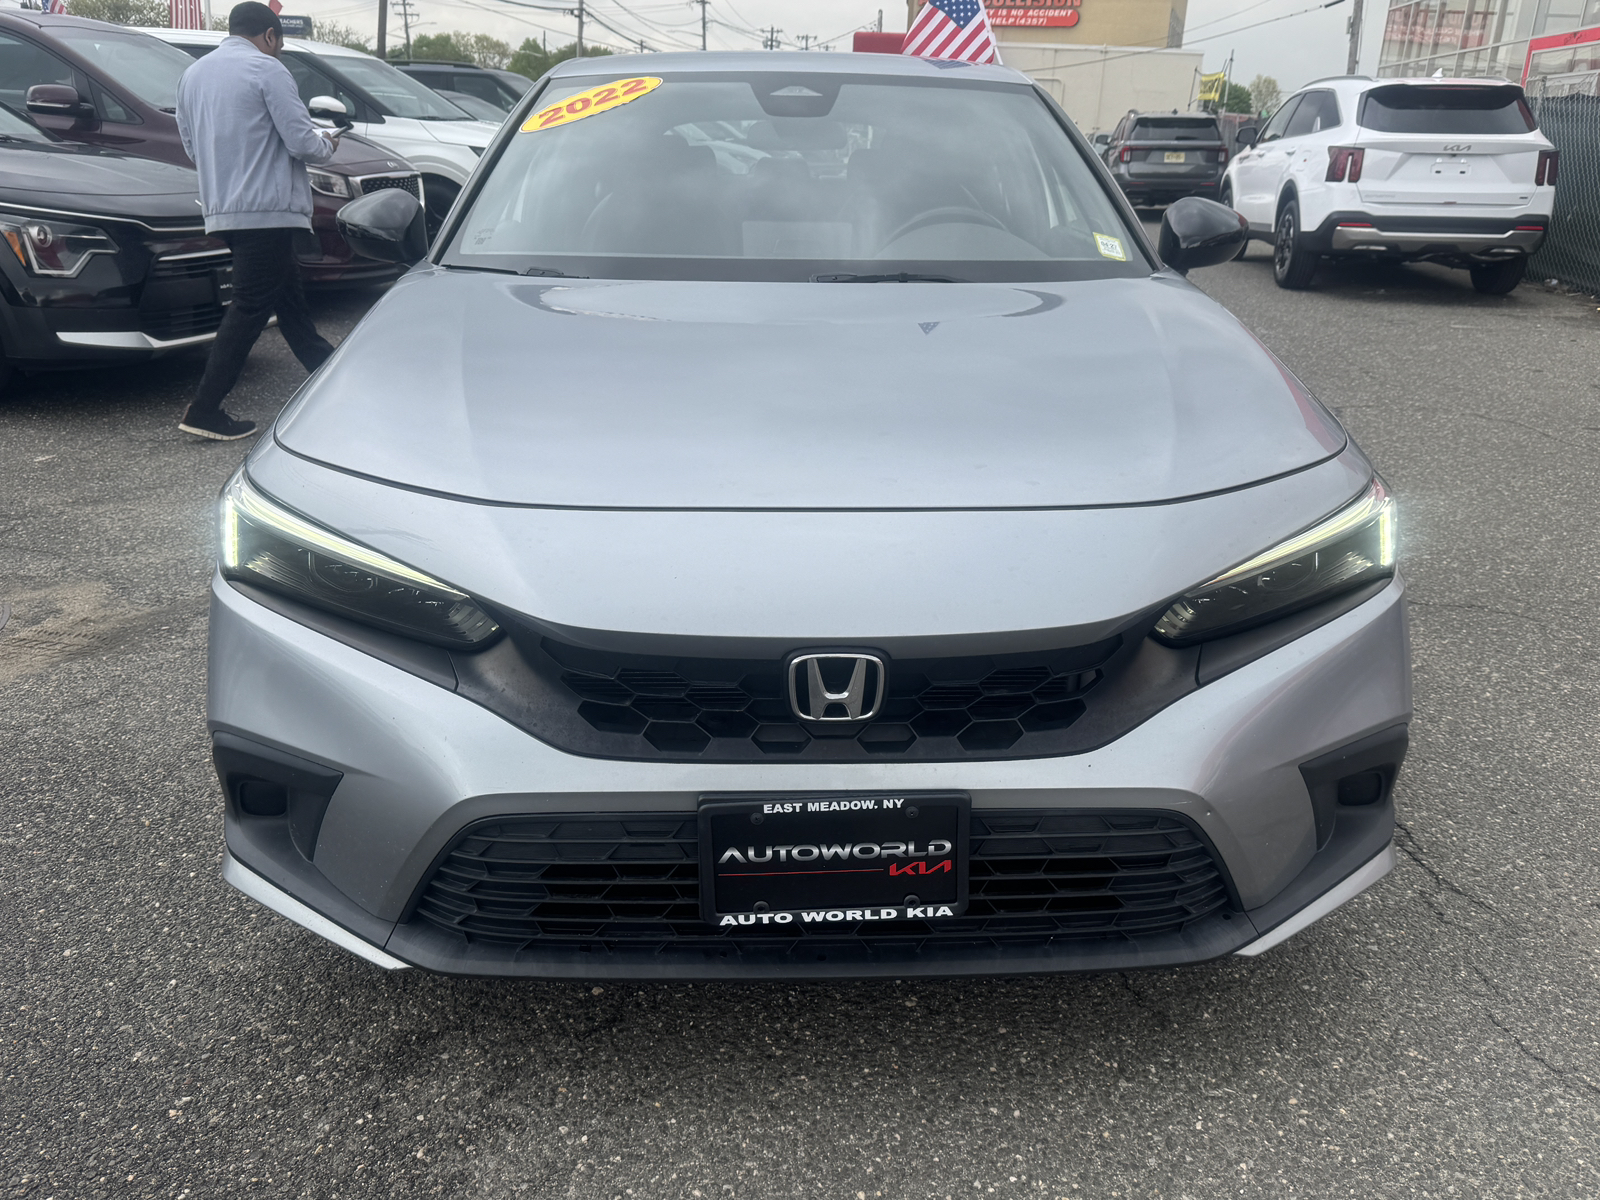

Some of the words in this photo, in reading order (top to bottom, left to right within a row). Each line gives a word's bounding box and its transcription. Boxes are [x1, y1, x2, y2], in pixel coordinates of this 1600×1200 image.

[990, 17, 1016, 26] HELP
[1016, 17, 1047, 26] (4357)
[998, 8, 1007, 17] IS
[1010, 8, 1024, 17] NO
[1027, 9, 1073, 17] ACCIDENT
[538, 78, 648, 128] 2022
[763, 803, 803, 814] EAST
[882, 798, 905, 809] NY
[718, 839, 952, 863] AUTOWORLD
[889, 859, 952, 877] KIA
[719, 912, 793, 926] AUTO
[801, 908, 898, 922] WORLD
[906, 906, 954, 918] KIA
